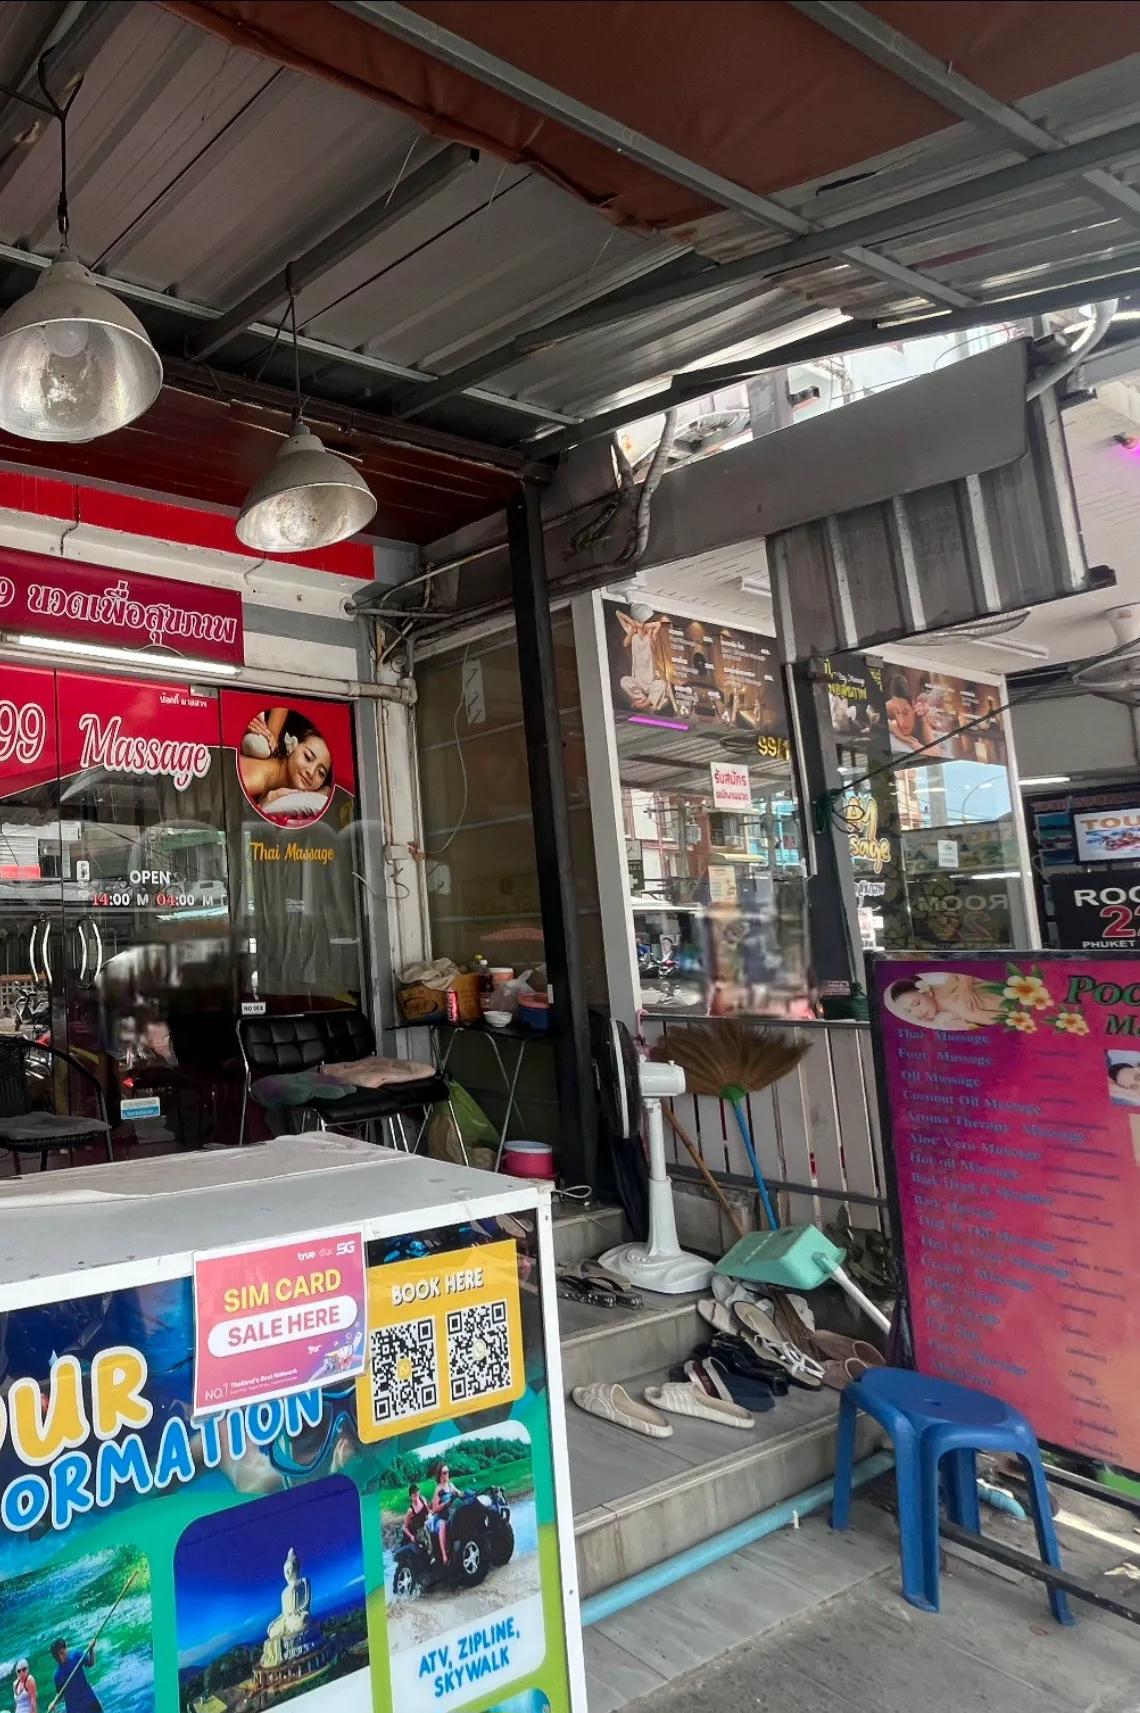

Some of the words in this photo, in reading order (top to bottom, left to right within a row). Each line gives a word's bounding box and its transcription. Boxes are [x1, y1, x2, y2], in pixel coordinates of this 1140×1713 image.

[27, 580, 237, 645] นวดเพื่อสุขภาพ
[79, 714, 211, 791] Massage
[758, 736, 790, 760] 99/1
[251, 842, 280, 861] Thai
[284, 843, 335, 865] Massage
[129, 870, 172, 884] OPEN
[92, 894, 130, 906] 14:00
[156, 894, 195, 906] 04:00
[1100, 905, 1140, 938] 2
[1082, 940, 1136, 949] PHUKET
[1105, 1014, 1140, 1035] M
[897, 1028, 924, 1040] Thai
[935, 1030, 990, 1044] Massage
[937, 1051, 993, 1066] Massage
[925, 1073, 981, 1087] Massage
[985, 1100, 1042, 1115] Massage
[1023, 1125, 1088, 1142] Massage
[981, 1142, 1042, 1161] Massage
[297, 1250, 316, 1261] true
[336, 1240, 356, 1256] 5G
[224, 1284, 270, 1313] SIM
[275, 1268, 343, 1299] CARD
[391, 1277, 442, 1307] BOOK
[446, 1267, 485, 1295] HERE
[228, 1317, 286, 1348] SALE
[287, 1304, 341, 1336] HERE
[418, 1645, 452, 1678] ATV,
[457, 1616, 520, 1661] ZIPLINE,
[434, 1649, 510, 1698] SKYWALK
